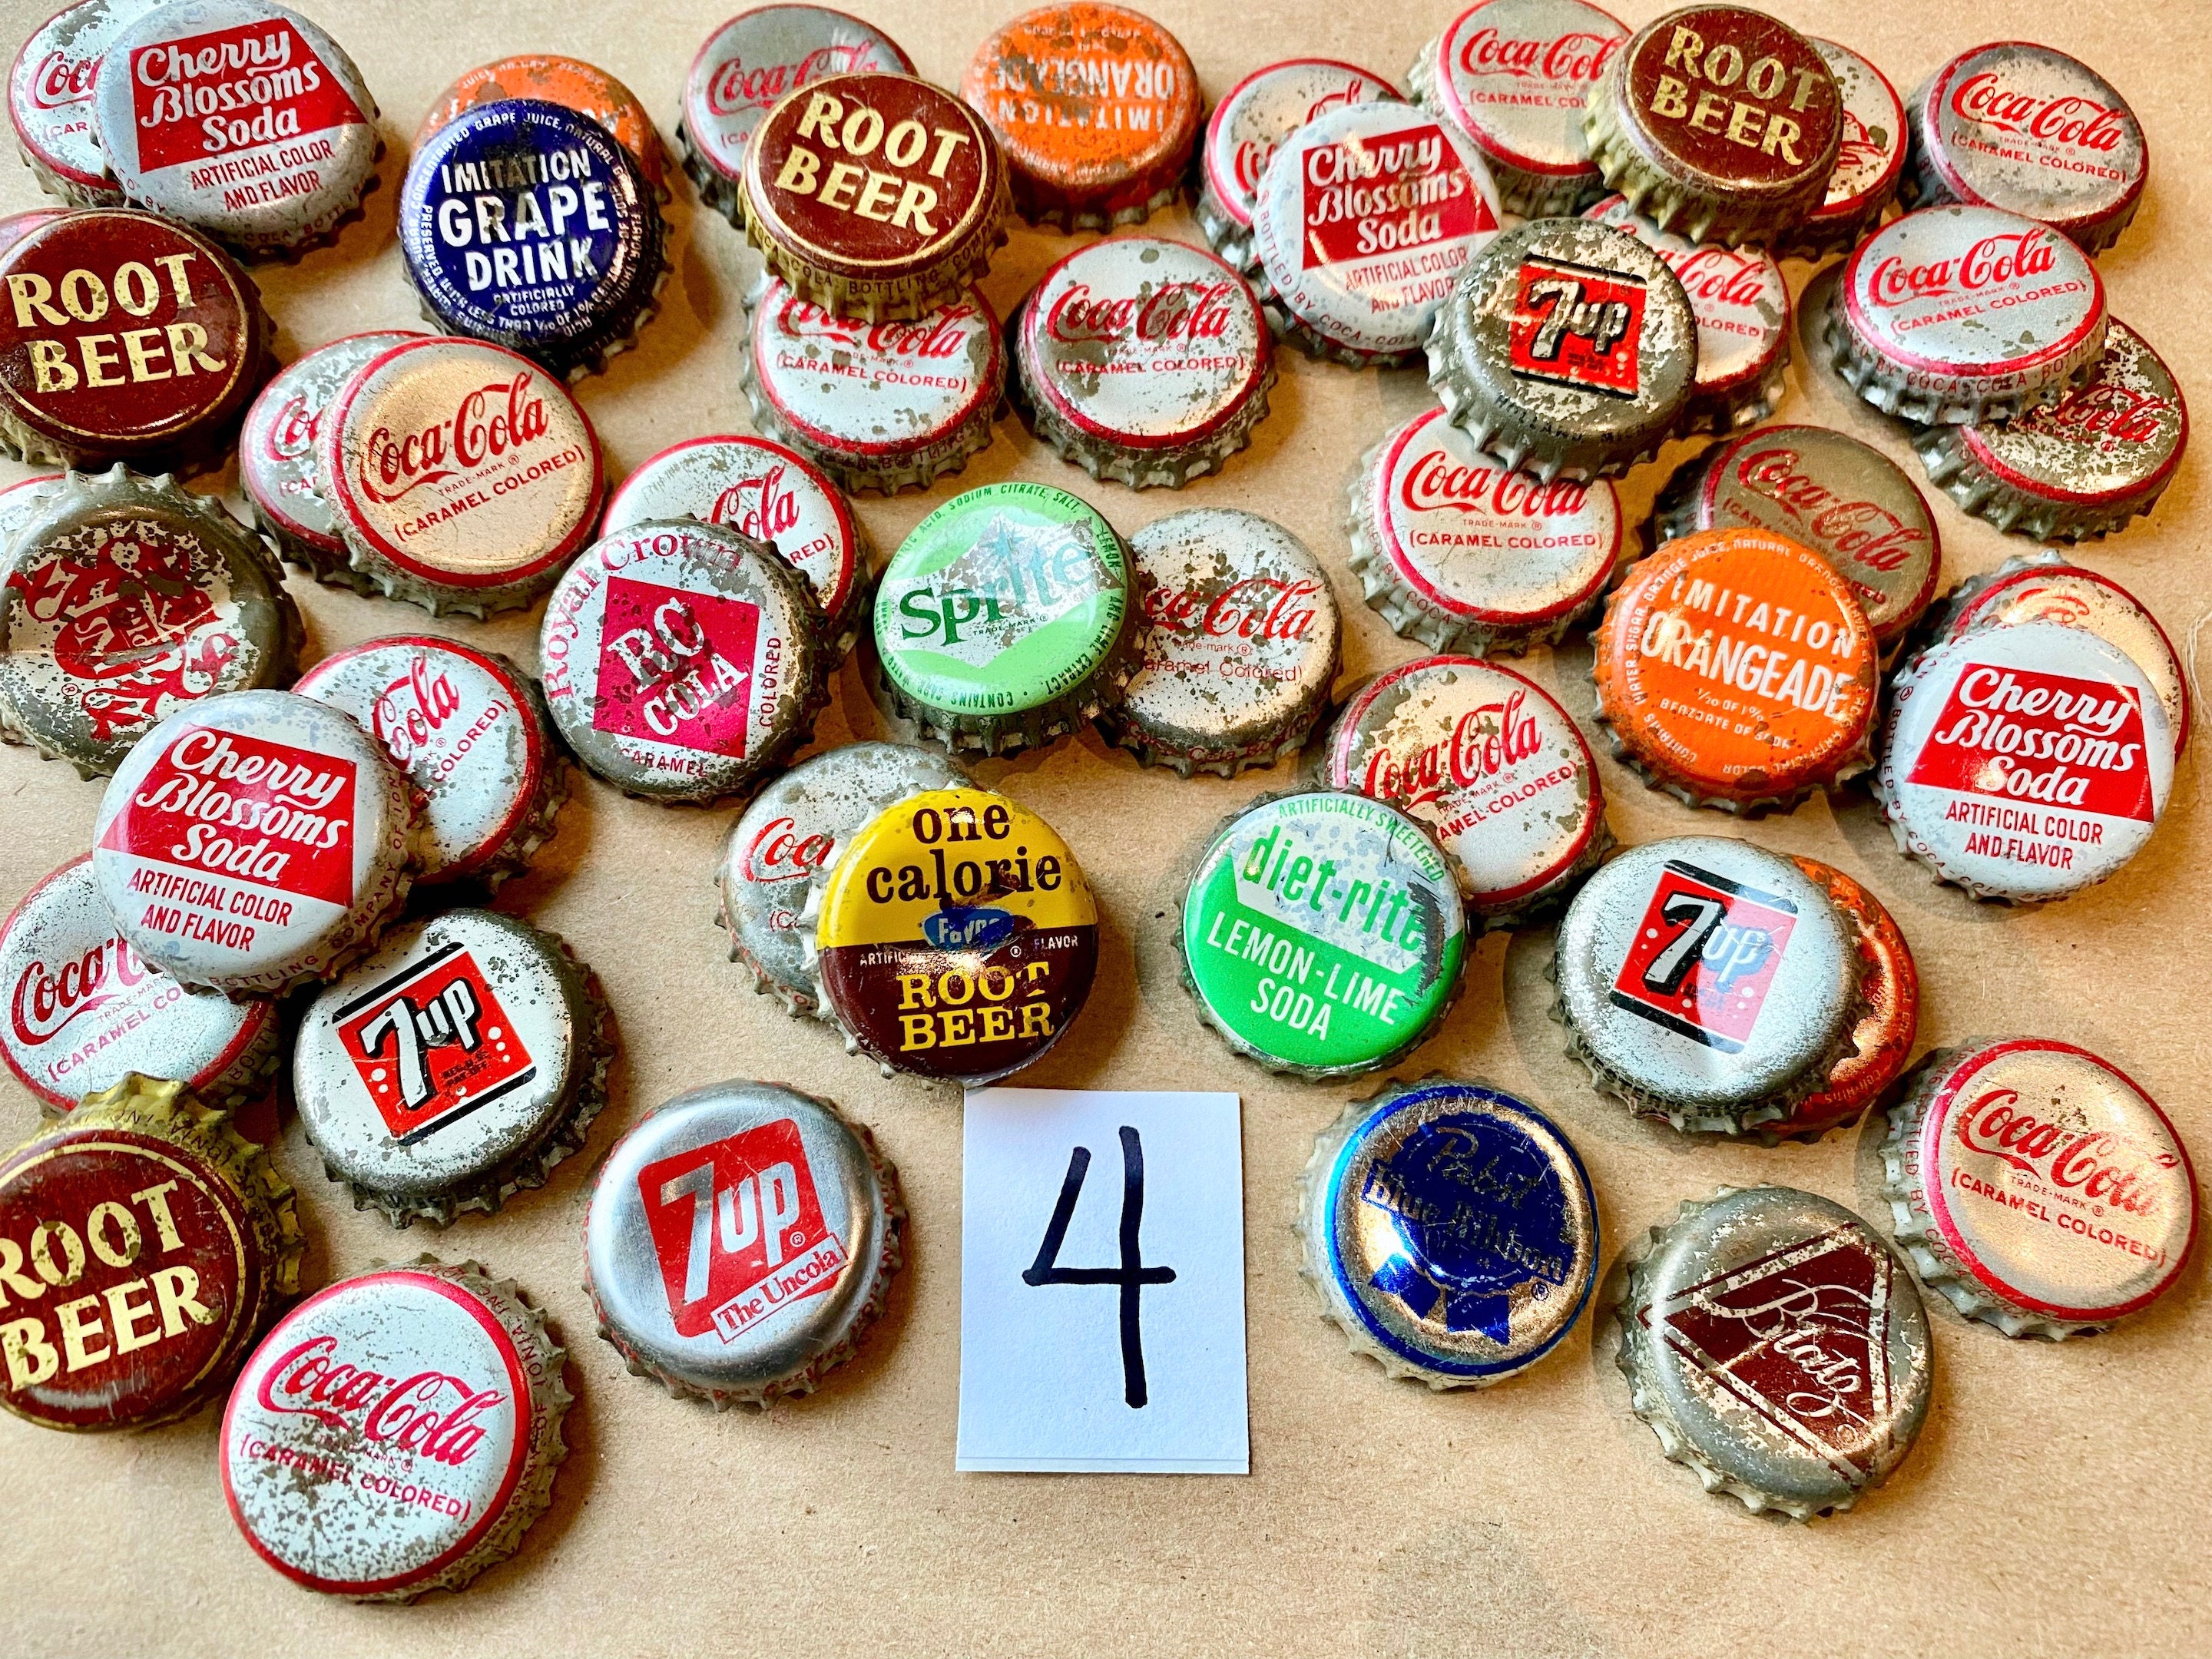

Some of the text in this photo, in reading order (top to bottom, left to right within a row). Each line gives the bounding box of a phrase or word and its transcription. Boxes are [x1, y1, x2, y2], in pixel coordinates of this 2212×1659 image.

[137, 31, 290, 87] Cherry
[1461, 27, 1632, 79] Coca-Col
[1665, 25, 1825, 114] ROOT
[141, 61, 321, 128] Blossoms
[998, 99, 1164, 131] IMITATION
[1469, 89, 1554, 107] (CARAMEL
[1649, 74, 1803, 166] BEER
[1951, 73, 2128, 152] Coca-Cola
[203, 108, 301, 152] Soda
[473, 112, 516, 132] GRAPE
[797, 91, 969, 178] ROOT
[190, 139, 335, 190] ARTIFICIAL COLOR
[442, 148, 591, 194] IMITATION
[1308, 134, 1442, 187] Cherry
[1951, 131, 2126, 183] (CARAMEL COLORED)
[224, 171, 323, 211] AND FLAVOR
[438, 182, 608, 247] GRAPE
[774, 144, 939, 237] BEER
[1308, 169, 1465, 227] Blossoms
[1357, 210, 1442, 254] Soda
[422, 204, 443, 276] PRESERVED
[555, 310, 570, 326] OF
[465, 237, 600, 291] DRINK
[849, 269, 939, 299] BOTTLING
[1260, 210, 1293, 286] BOTTLED
[1295, 292, 1314, 311] BY
[1345, 245, 1468, 290] ARTIFICIAL COLOR
[1868, 228, 2056, 308] Coca-Cola
[5, 251, 197, 327] ROOT
[493, 285, 575, 303] ARTIFICIALLY
[510, 300, 565, 316] COLORED
[1402, 277, 1456, 307] FLAVOR
[1890, 278, 2087, 335] (CARAMEL COLORED)
[25, 322, 227, 393] BEER
[874, 369, 966, 393] COLORED)
[1153, 355, 1244, 372] COLORED)
[1876, 357, 1894, 376] BY
[360, 372, 548, 505] Coca-Cola
[394, 443, 585, 543] (CARAMEL COLORED)
[438, 462, 505, 496] TRADE-MARK
[948, 486, 992, 511] SODIUM
[1001, 484, 1046, 498] CITRATE,
[1053, 492, 1080, 513] SALT,
[1409, 529, 1604, 550] (CARAMEL COLORED)
[1462, 518, 1527, 529] TRADE-MARK
[1733, 538, 1790, 557] NATURAL
[1382, 562, 1401, 584] BY
[545, 533, 742, 702] Royal Crown
[1107, 596, 1124, 622] AND
[1671, 573, 1854, 658] IMITATION
[607, 596, 704, 694] RC
[1090, 625, 1117, 656] LIME
[1641, 611, 1854, 717] ORANGEADE
[643, 651, 750, 737] COLA
[759, 637, 781, 728] COLORED
[1722, 699, 1737, 711] OF
[1959, 668, 2132, 737] Cherry
[1734, 723, 1751, 736] OF
[1881, 709, 1902, 790] BOTTLED
[1935, 710, 2141, 773] Blossoms
[169, 730, 346, 810] Cherry
[1487, 760, 1580, 814] COLORED)
[1975, 756, 2091, 806] Soda
[135, 772, 349, 849] Blossoms
[912, 803, 1011, 844] one
[1891, 798, 1910, 823] BY
[1946, 800, 2102, 845] ARTIFICIAL COLOR
[171, 822, 292, 882] Soda
[1278, 798, 1445, 882] ARTIFICIALLY SWEETENED
[1965, 833, 2073, 870] AND FLAVOR
[127, 867, 293, 927] ARTIFICIAL COLOR
[866, 846, 1063, 903] calorie
[1242, 824, 1423, 952] diet-rite
[141, 903, 255, 952] AND FLAVOR
[208, 955, 319, 987] BOTTLING
[393, 824, 402, 850] OF
[896, 960, 1051, 1010] ROOT
[1250, 978, 1333, 1041] SODA
[46, 1008, 151, 1083] (CARAMEL
[898, 1002, 1055, 1053] BEER
[1909, 1188, 1929, 1215] BY
[1951, 1167, 2167, 1269] (CARAMEL COLORED)
[2010, 1175, 2088, 1210] TRADE-MARK
[0, 1179, 186, 1306] ROOT
[1022, 1124, 1177, 1409] 4
[716, 1247, 842, 1331] The Uncola
[0, 1265, 223, 1393] BEER
[257, 1334, 508, 1467] Coca-Cola
[361, 1472, 471, 1522] COLORED)
